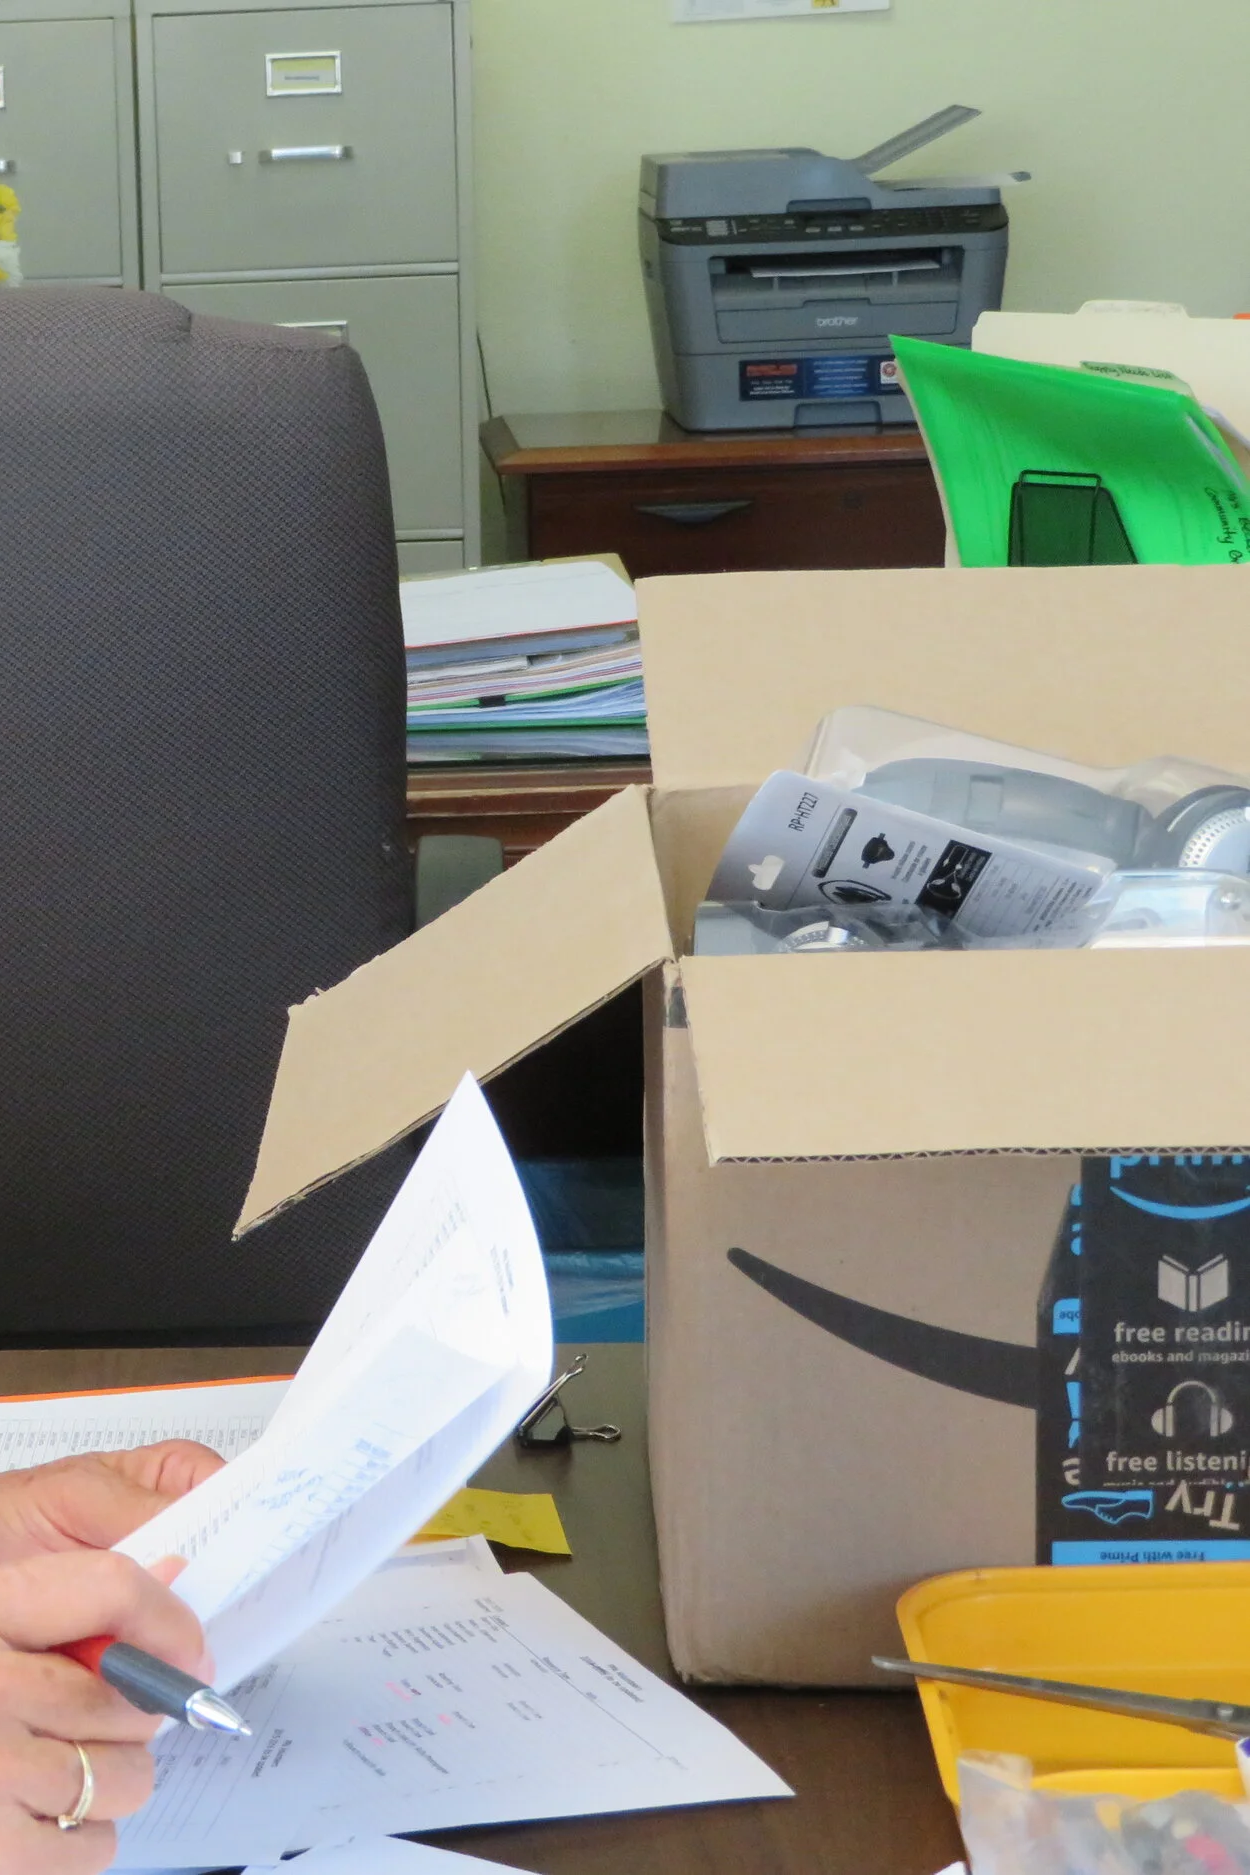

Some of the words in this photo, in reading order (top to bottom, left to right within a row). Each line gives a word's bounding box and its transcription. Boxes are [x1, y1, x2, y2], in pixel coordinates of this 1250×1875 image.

[815, 316, 859, 328] brother
[1114, 1322, 1166, 1343] free
[1112, 1350, 1164, 1363] ebooks
[1167, 1350, 1194, 1363] and
[1106, 1451, 1158, 1472] free
[1164, 1478, 1240, 1531] Try
[1100, 1550, 1139, 1563] Prime
[1143, 1550, 1172, 1563] with
[1176, 1550, 1206, 1563] Free
